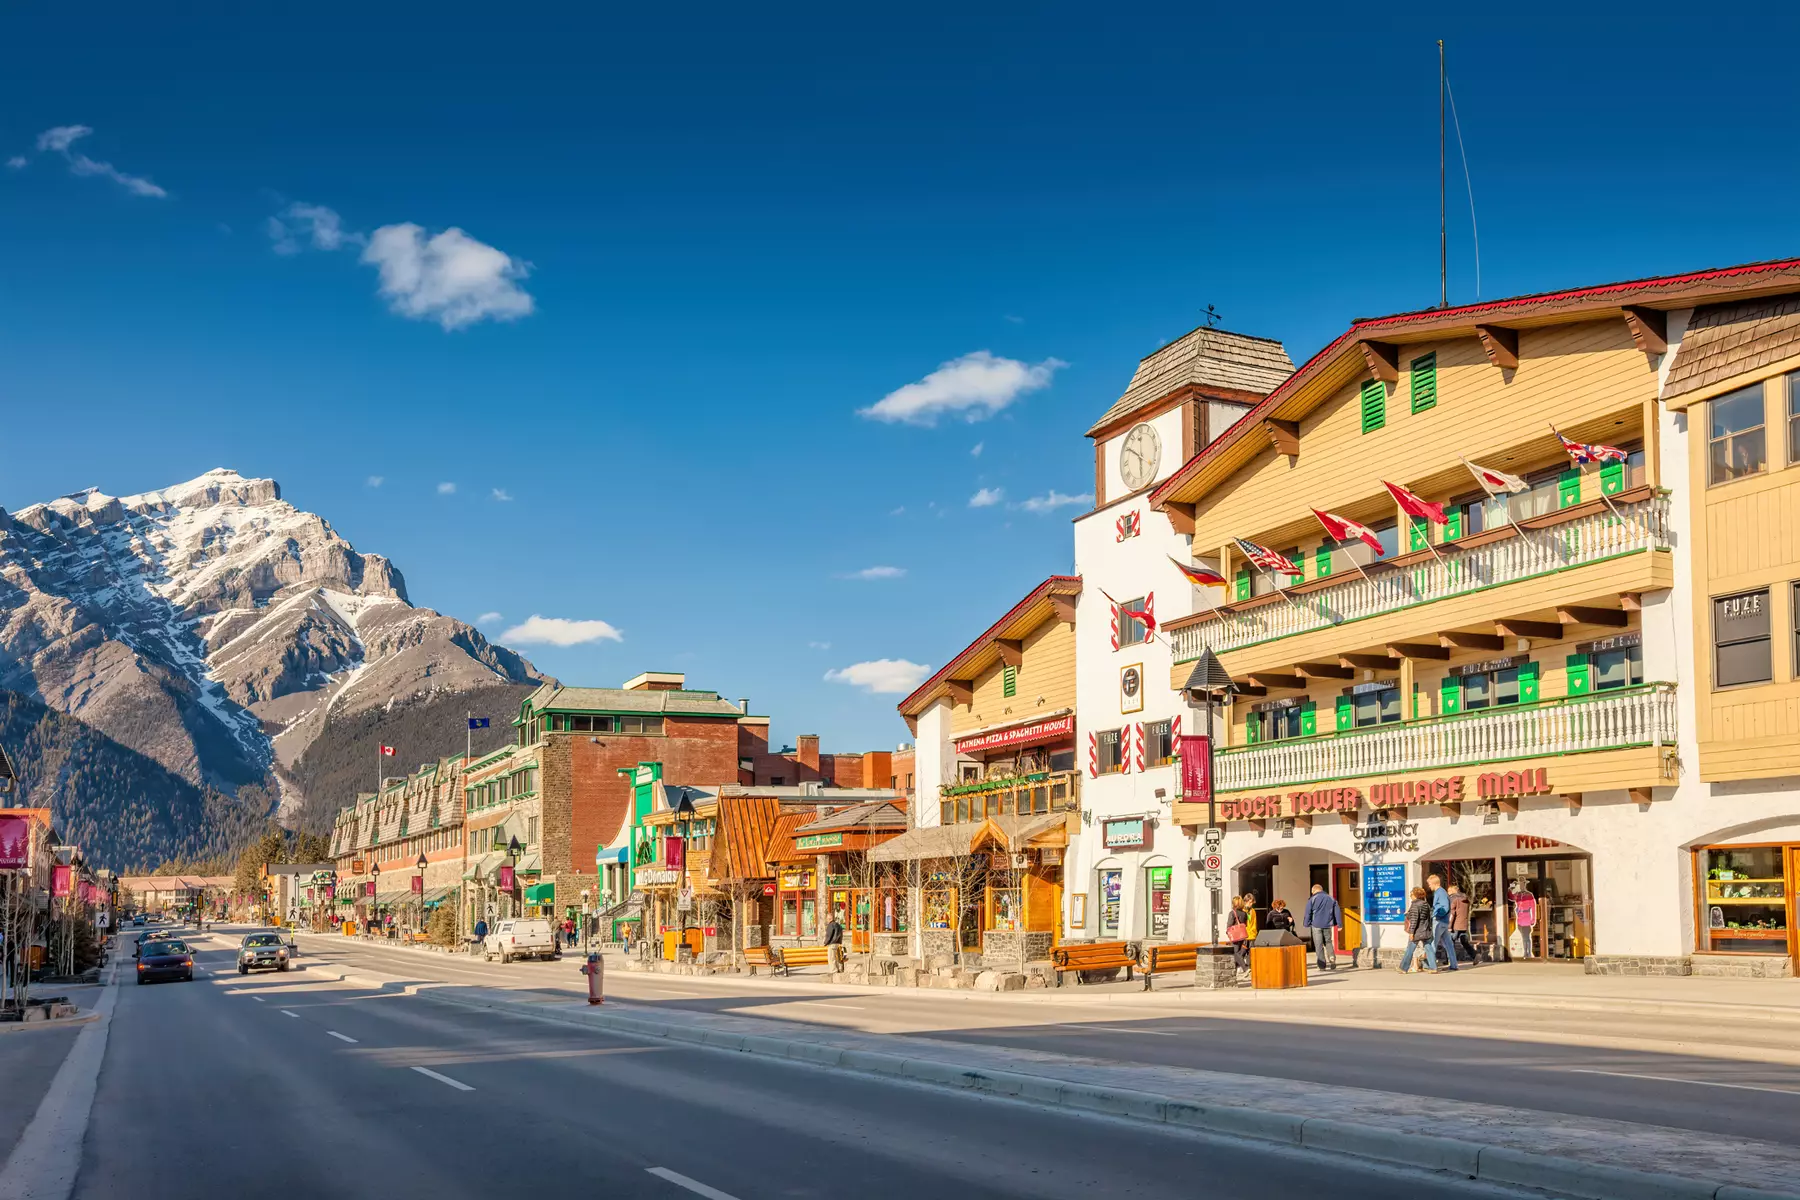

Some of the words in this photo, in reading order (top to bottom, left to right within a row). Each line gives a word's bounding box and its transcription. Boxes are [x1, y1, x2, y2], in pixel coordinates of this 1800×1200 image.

[1724, 595, 1760, 613] FUZE
[1593, 637, 1624, 651] FUZE
[1462, 662, 1488, 675] FUZE
[961, 737, 984, 749] ATHENA
[986, 733, 1003, 744] PIZZA
[1009, 724, 1042, 739] SPAGHETTI
[1044, 719, 1066, 733] HOUSE
[1152, 723, 1167, 735] FUZE
[1103, 732, 1118, 743] FUZE
[1221, 795, 1280, 819] CLOCK
[1287, 787, 1360, 813] TOWER
[1370, 776, 1465, 807] VILLAGE
[1477, 767, 1551, 797] MALL
[1106, 832, 1143, 842] AURORA
[1353, 823, 1419, 840] CURRENCY
[1354, 838, 1420, 855] EXCHANGE
